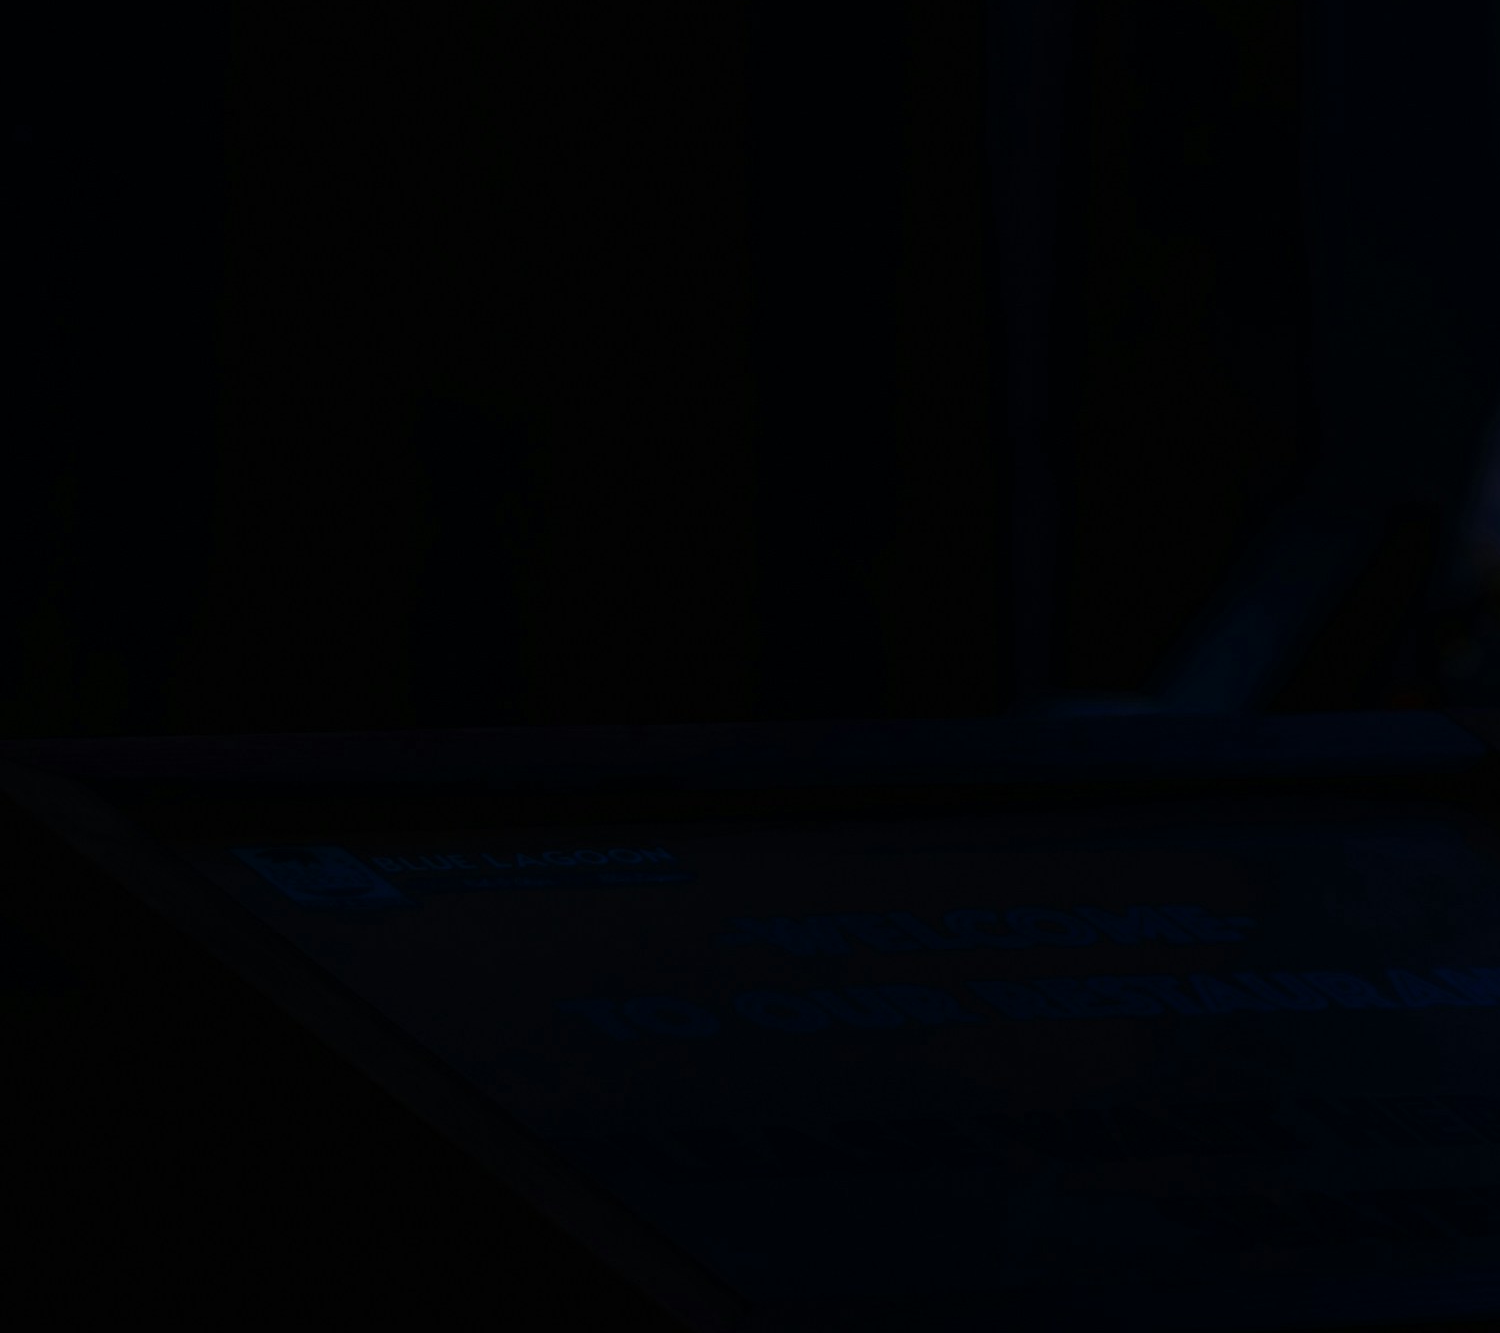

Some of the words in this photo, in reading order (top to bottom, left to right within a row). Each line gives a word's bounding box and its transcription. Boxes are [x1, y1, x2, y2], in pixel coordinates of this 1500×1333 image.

[371, 853, 477, 874] BLUE
[481, 846, 677, 870] LAGOON
[553, 996, 720, 1041] TO
[732, 985, 978, 1034] OUR
